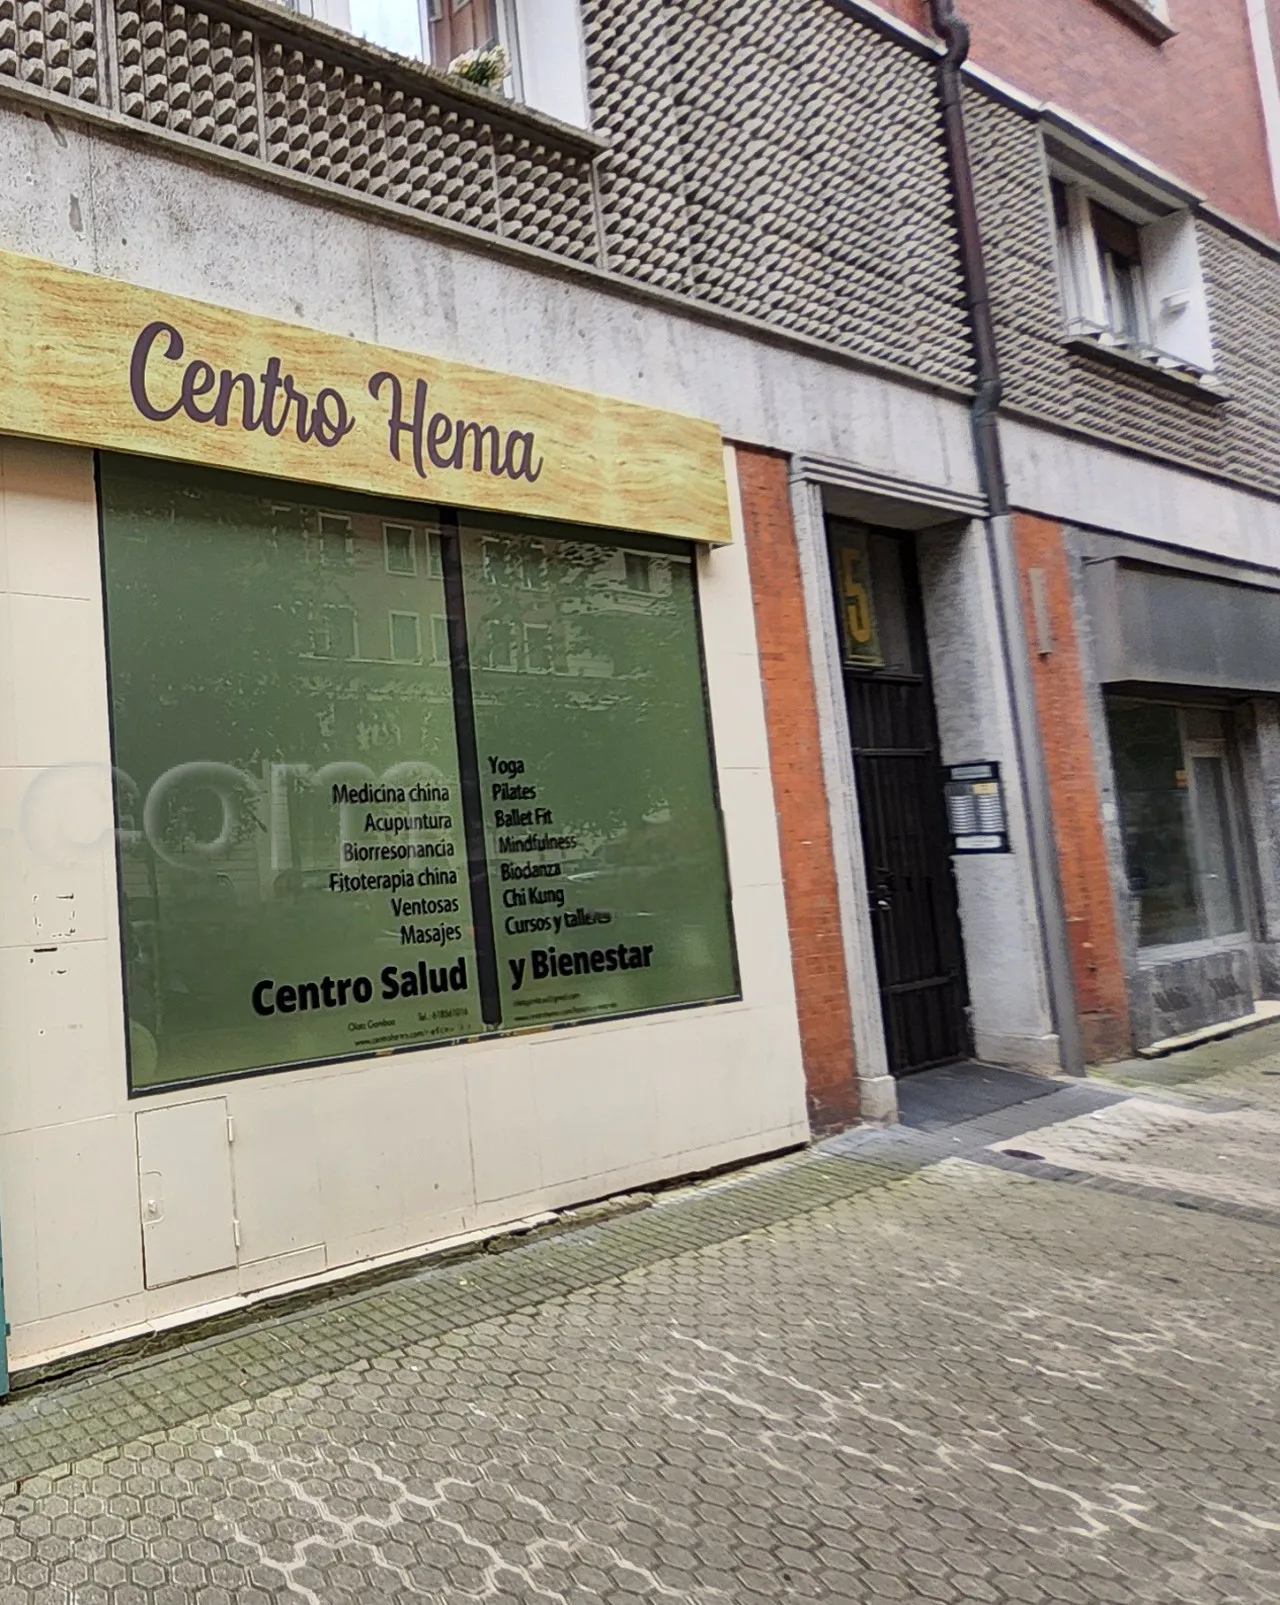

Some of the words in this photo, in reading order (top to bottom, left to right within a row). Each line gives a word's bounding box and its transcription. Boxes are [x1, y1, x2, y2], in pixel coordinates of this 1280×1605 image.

[129, 320, 356, 448] Centro
[368, 371, 544, 483] Hema
[488, 755, 526, 779] Yoga
[332, 783, 406, 805] Medicina
[409, 783, 450, 802] china
[492, 783, 537, 801] Pilates
[364, 813, 453, 836] Acupuntura
[494, 808, 533, 828] Ballet
[535, 807, 554, 826] Fit
[343, 838, 455, 862] Biorresonancia
[498, 832, 578, 854] Mindfulness
[329, 868, 415, 893] Fitoterapia
[418, 866, 458, 887] china
[500, 861, 562, 882] Biodanza
[391, 897, 459, 917] Ventosas
[503, 887, 527, 908] Chi
[528, 886, 565, 908] Kung
[400, 922, 463, 947] Masajes
[505, 915, 552, 936] Cursos
[553, 914, 562, 935] y
[250, 973, 374, 1018] Centro
[380, 956, 468, 1001] Salud
[509, 957, 526, 991] y
[531, 941, 654, 981] Bienestar
